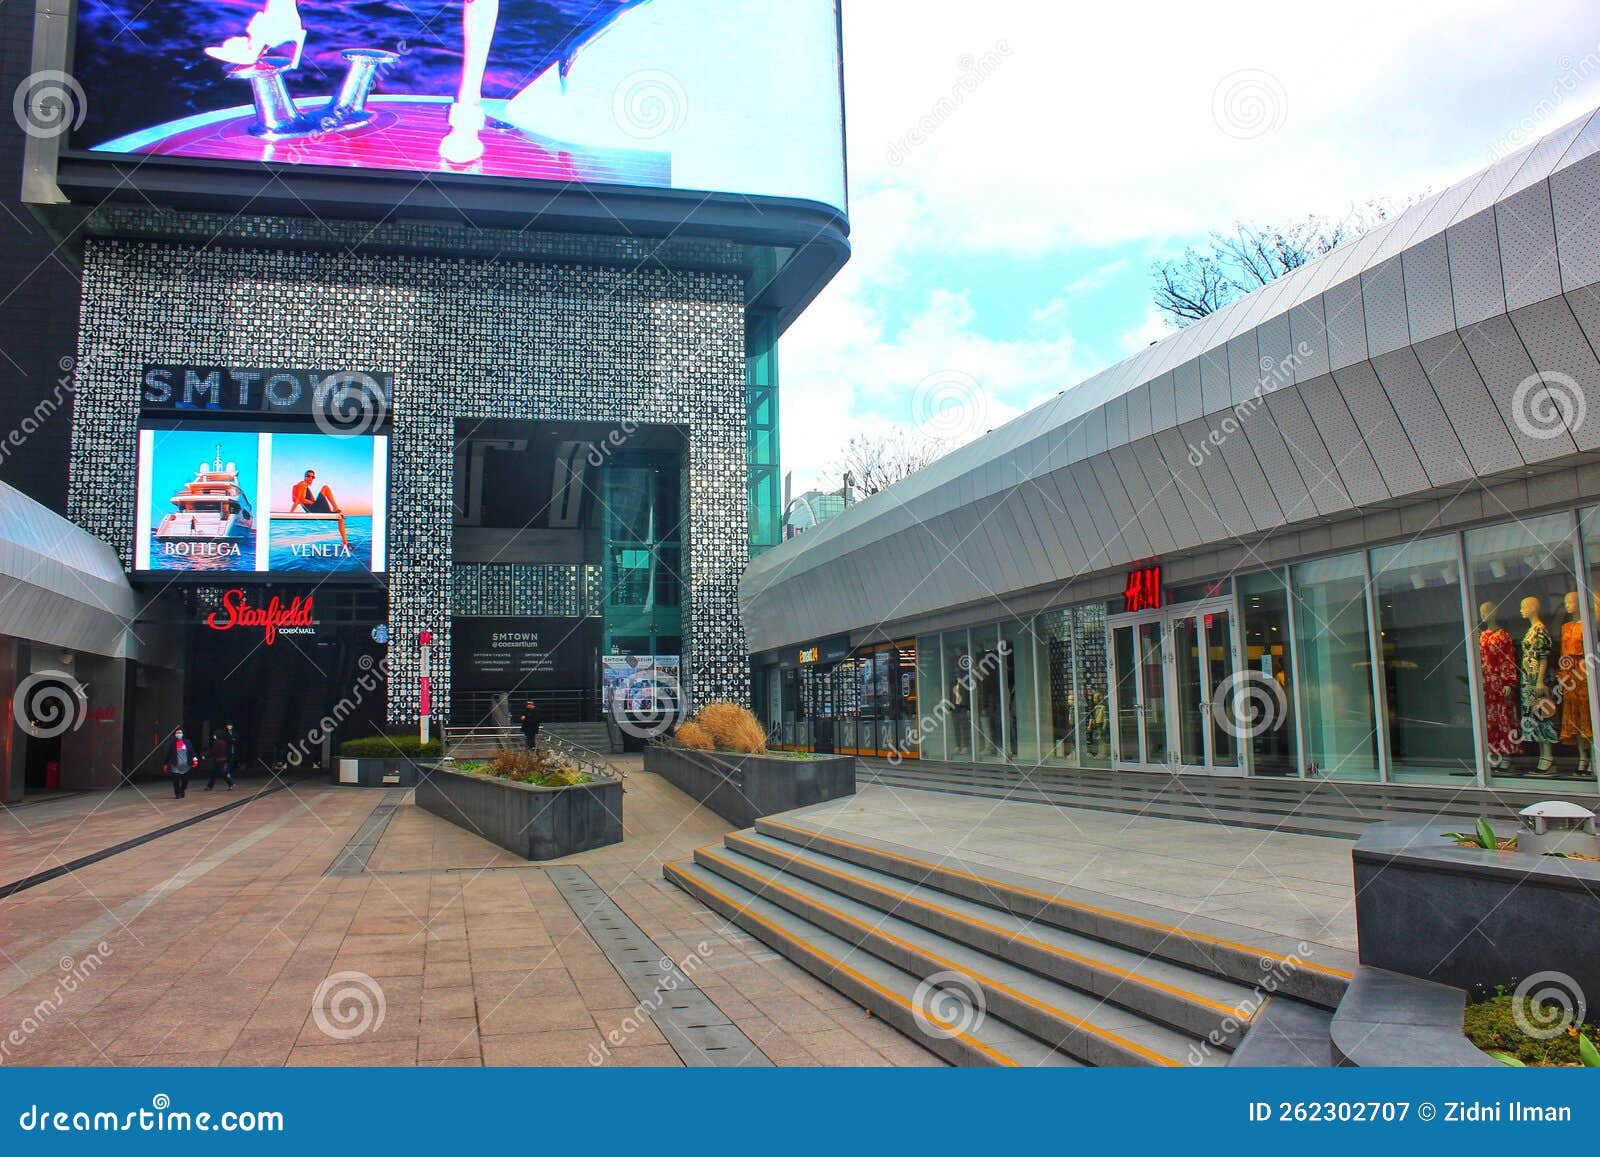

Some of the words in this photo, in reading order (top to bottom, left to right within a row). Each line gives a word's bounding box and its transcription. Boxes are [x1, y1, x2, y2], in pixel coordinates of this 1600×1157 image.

[144, 369, 393, 409] SMTOWN
[165, 542, 241, 556] BOTTEGA
[290, 544, 351, 557] VENETA
[207, 589, 313, 645] Starfield
[492, 633, 538, 641] SMTOWN
